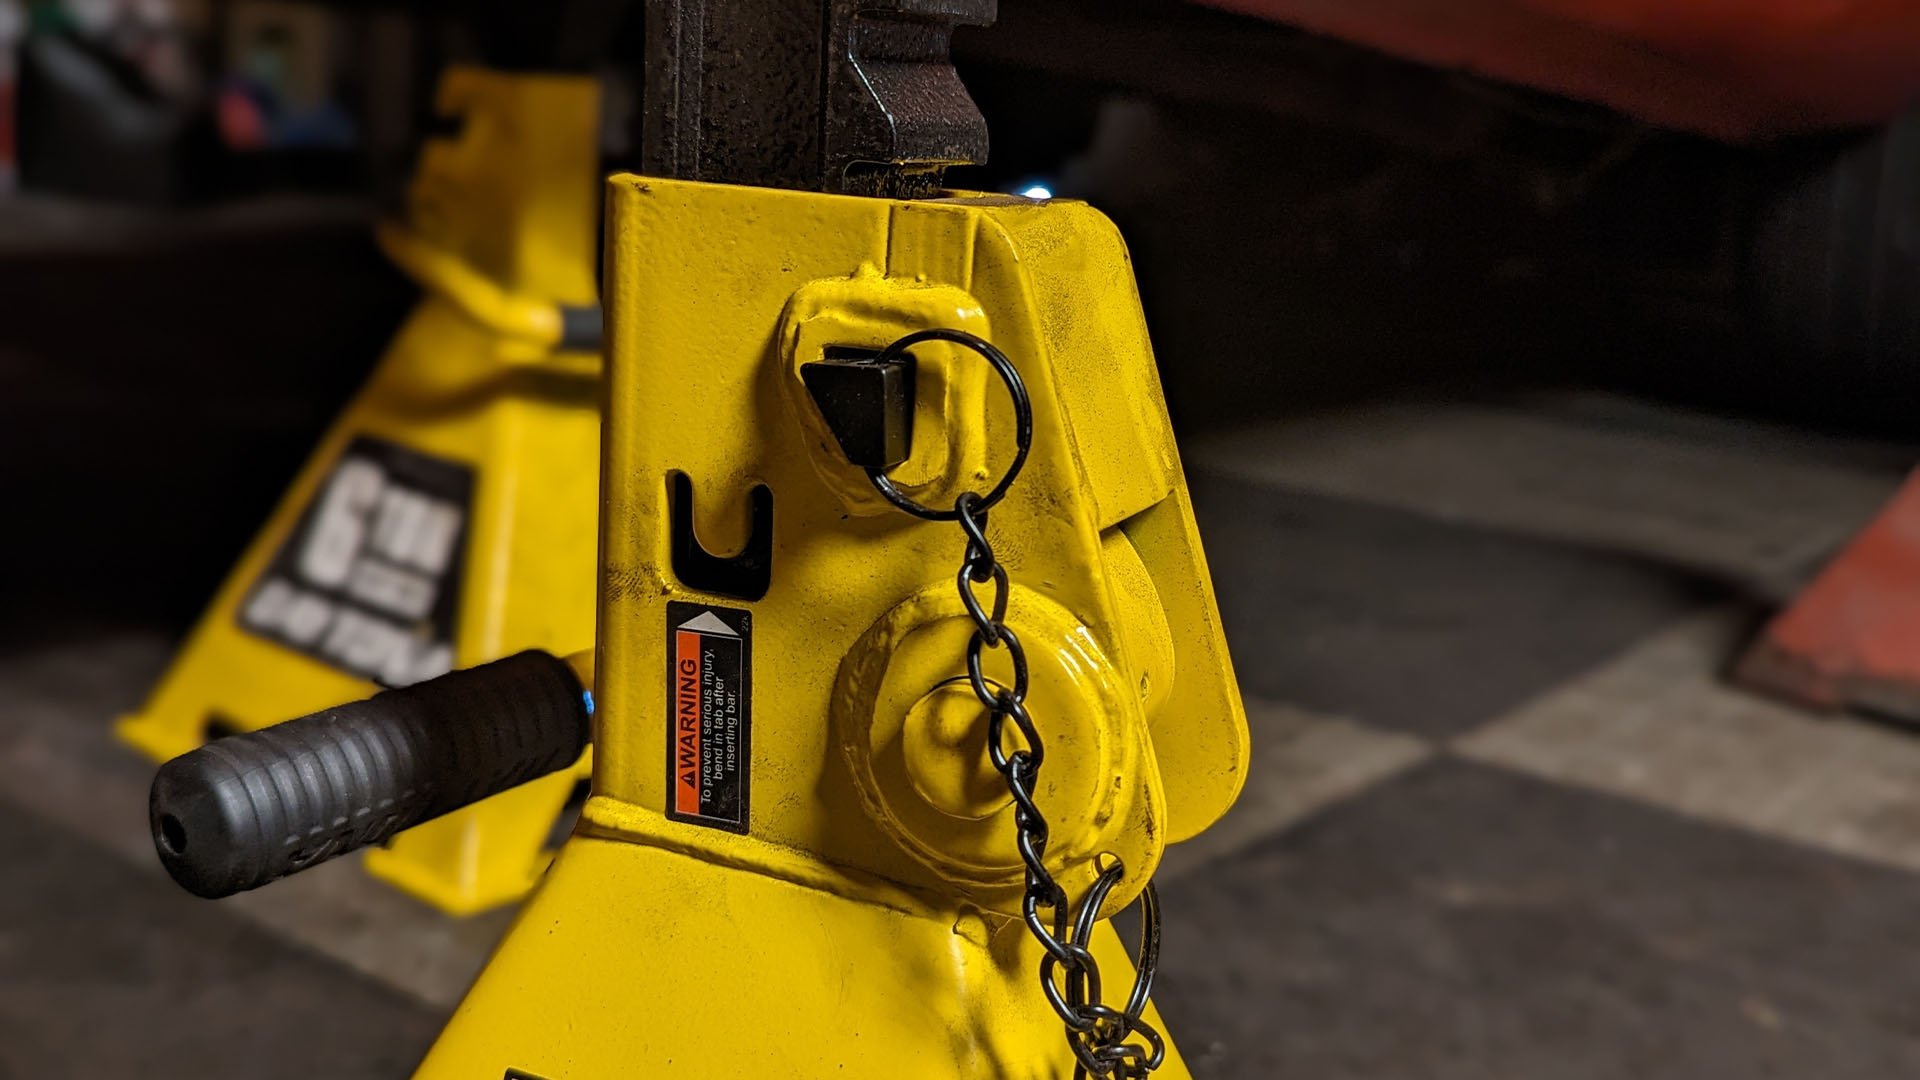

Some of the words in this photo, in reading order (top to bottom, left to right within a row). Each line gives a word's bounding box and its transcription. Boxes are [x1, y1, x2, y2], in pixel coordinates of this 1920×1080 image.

[702, 648, 715, 686] injury,
[713, 677, 725, 708] after
[725, 690, 736, 715] bar.
[680, 659, 697, 769] WARNING
[702, 689, 713, 735] serious
[713, 709, 724, 731] tab
[713, 734, 724, 747] in
[725, 717, 738, 772] inserting
[702, 739, 714, 787] prevent
[714, 749, 724, 780] bend
[701, 789, 711, 804] To
